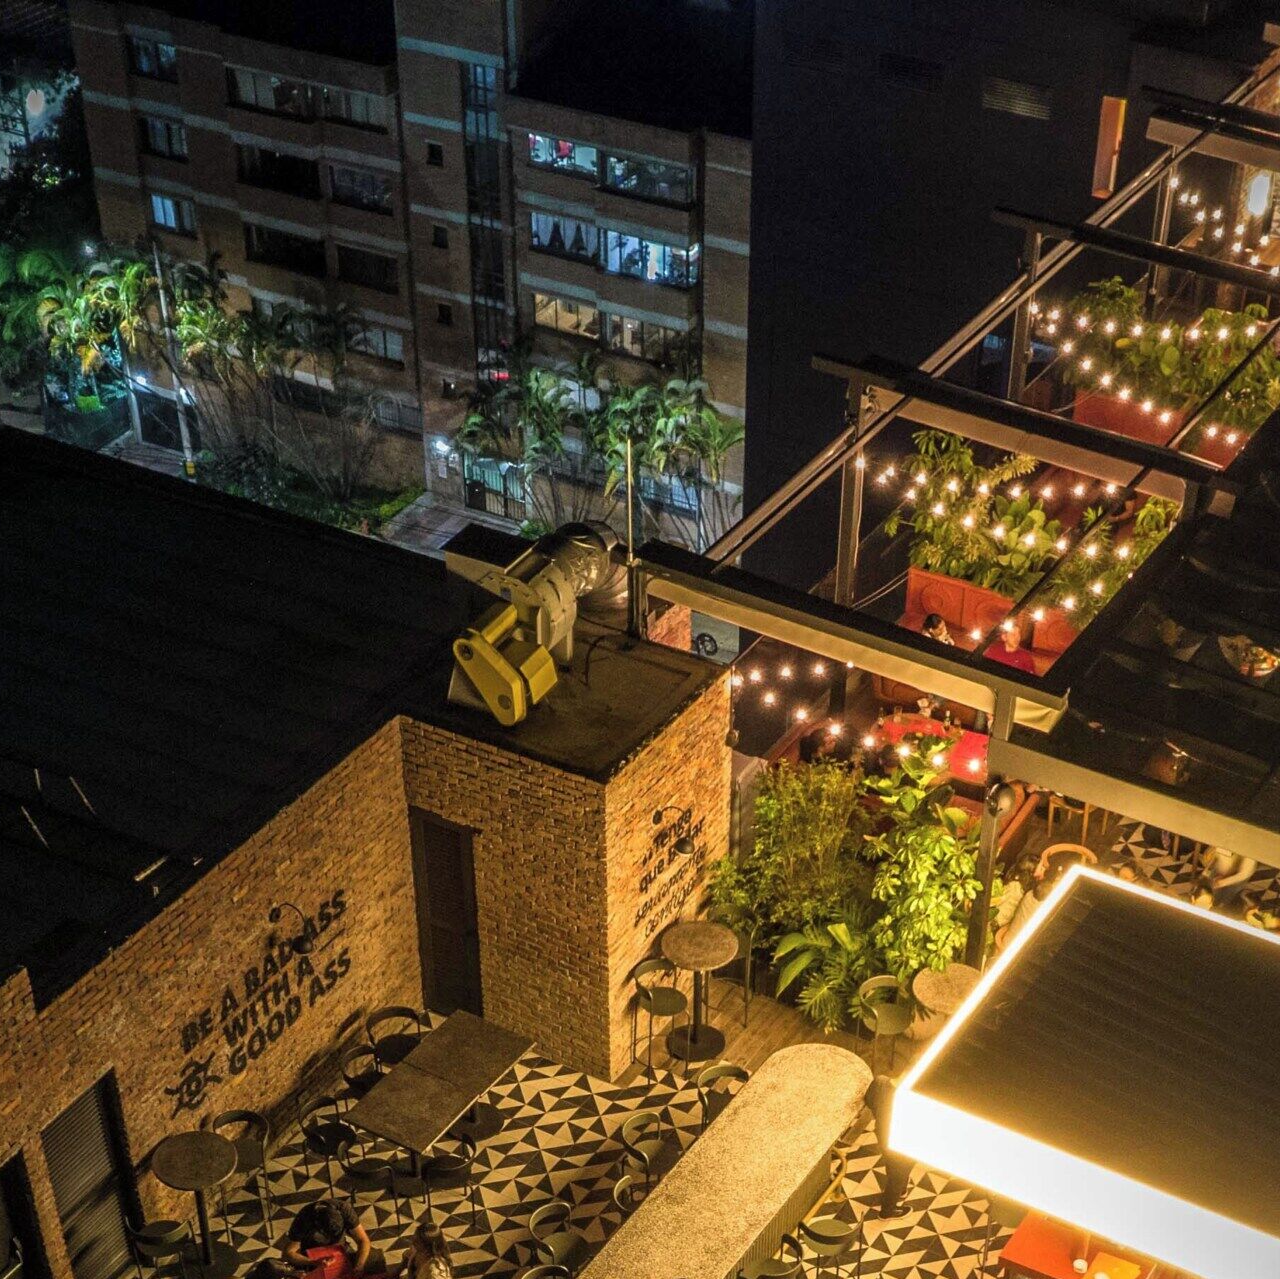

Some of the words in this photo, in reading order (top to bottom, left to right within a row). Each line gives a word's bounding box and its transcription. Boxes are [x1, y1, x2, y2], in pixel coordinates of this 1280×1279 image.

[639, 858, 665, 894] que
[181, 1007, 214, 1054] BE
[220, 985, 239, 1022] A
[222, 970, 291, 1047] WITH
[294, 955, 315, 988] A
[228, 995, 302, 1076] GOOD
[308, 947, 352, 1008] ASS
